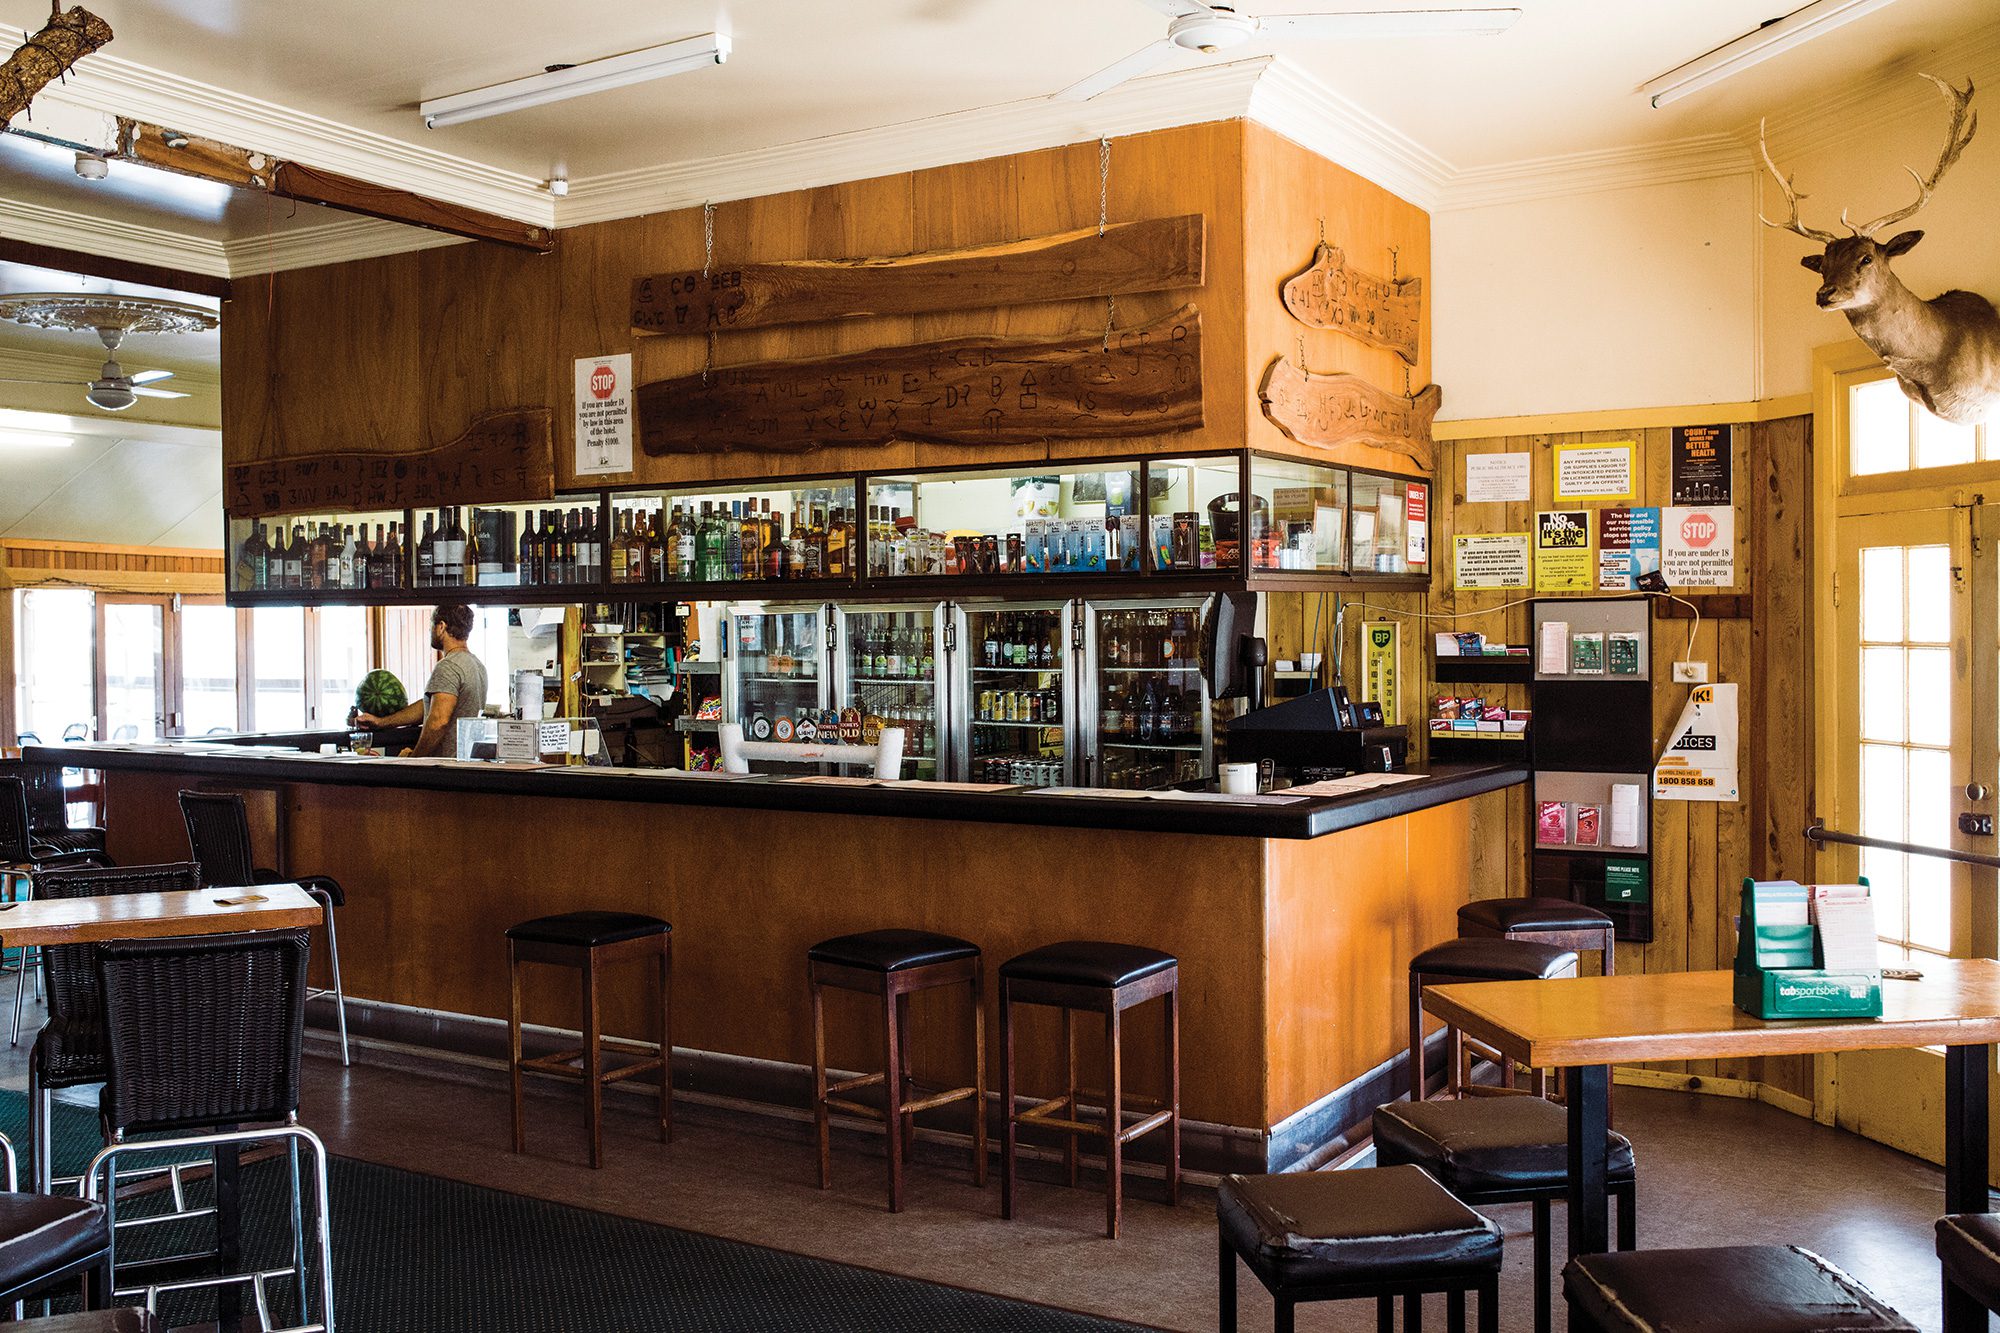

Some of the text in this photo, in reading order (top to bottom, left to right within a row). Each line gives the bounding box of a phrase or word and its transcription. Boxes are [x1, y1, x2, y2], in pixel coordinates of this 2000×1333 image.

[592, 375, 614, 391] STOP
[586, 402, 595, 410] you
[604, 399, 617, 407] under
[579, 412, 588, 420] you
[605, 407, 627, 419] permitted
[583, 420, 589, 428] by
[589, 419, 598, 427] law
[613, 417, 624, 425] area
[1684, 428, 1707, 436] COUNT
[587, 439, 604, 448] Penalty
[1686, 441, 1710, 449] BETTER
[1691, 449, 1715, 457] HEALTH
[1549, 513, 1568, 524] No
[1543, 521, 1579, 530] more.
[1543, 528, 1583, 539] It's the
[1683, 522, 1715, 539] STOP
[1552, 537, 1579, 545] Law.
[1674, 550, 1686, 558] you
[1663, 560, 1675, 568] you
[1701, 559, 1733, 568] permitted
[1668, 569, 1677, 577] by
[1678, 568, 1690, 576] law
[1700, 568, 1711, 576] this
[1374, 632, 1389, 643] BP
[817, 730, 838, 739] NEW
[839, 728, 859, 738] OLD
[1697, 778, 1714, 786] 858
[1780, 985, 1840, 996] tabsportsbet
